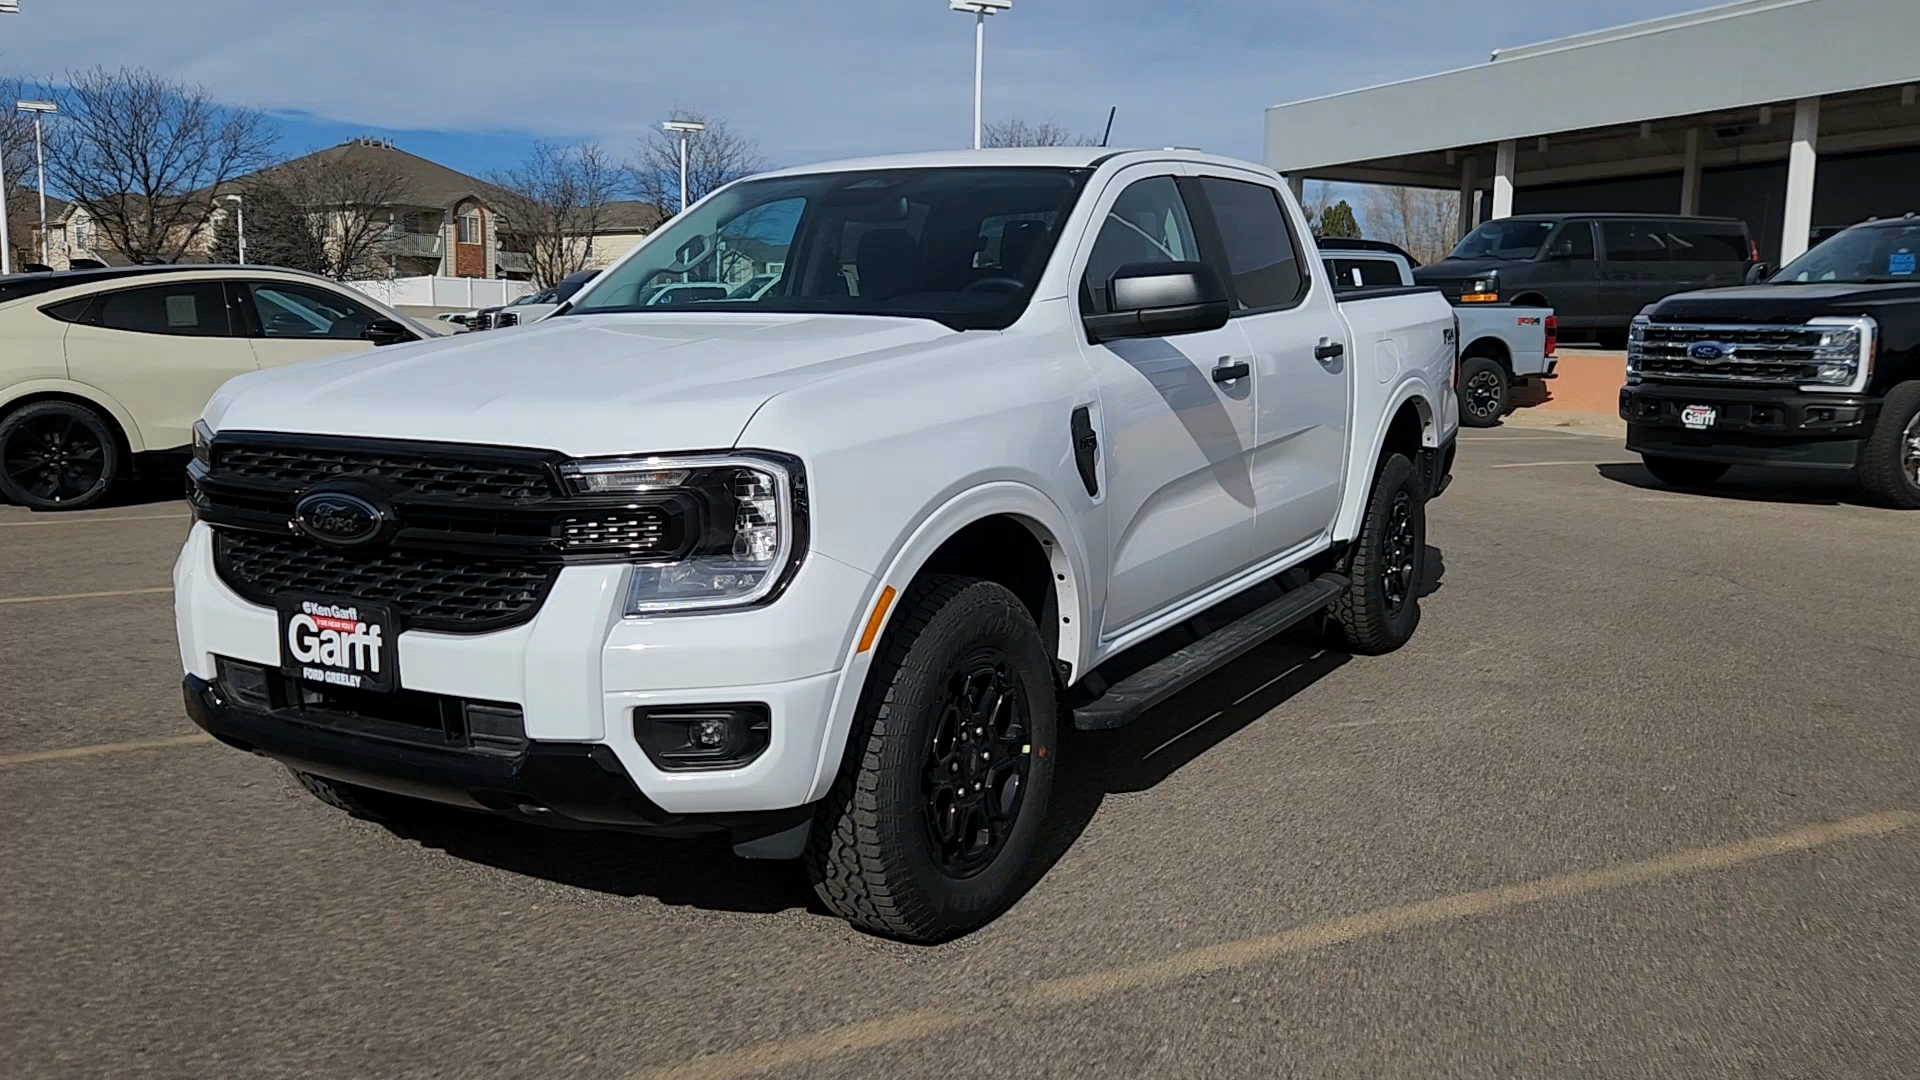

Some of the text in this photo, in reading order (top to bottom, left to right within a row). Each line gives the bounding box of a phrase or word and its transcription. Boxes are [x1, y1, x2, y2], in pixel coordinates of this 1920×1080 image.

[1681, 408, 1716, 426] Garff
[312, 502, 359, 533] Ford
[288, 613, 382, 673] Garff
[303, 667, 361, 688] FORD GREELEY
